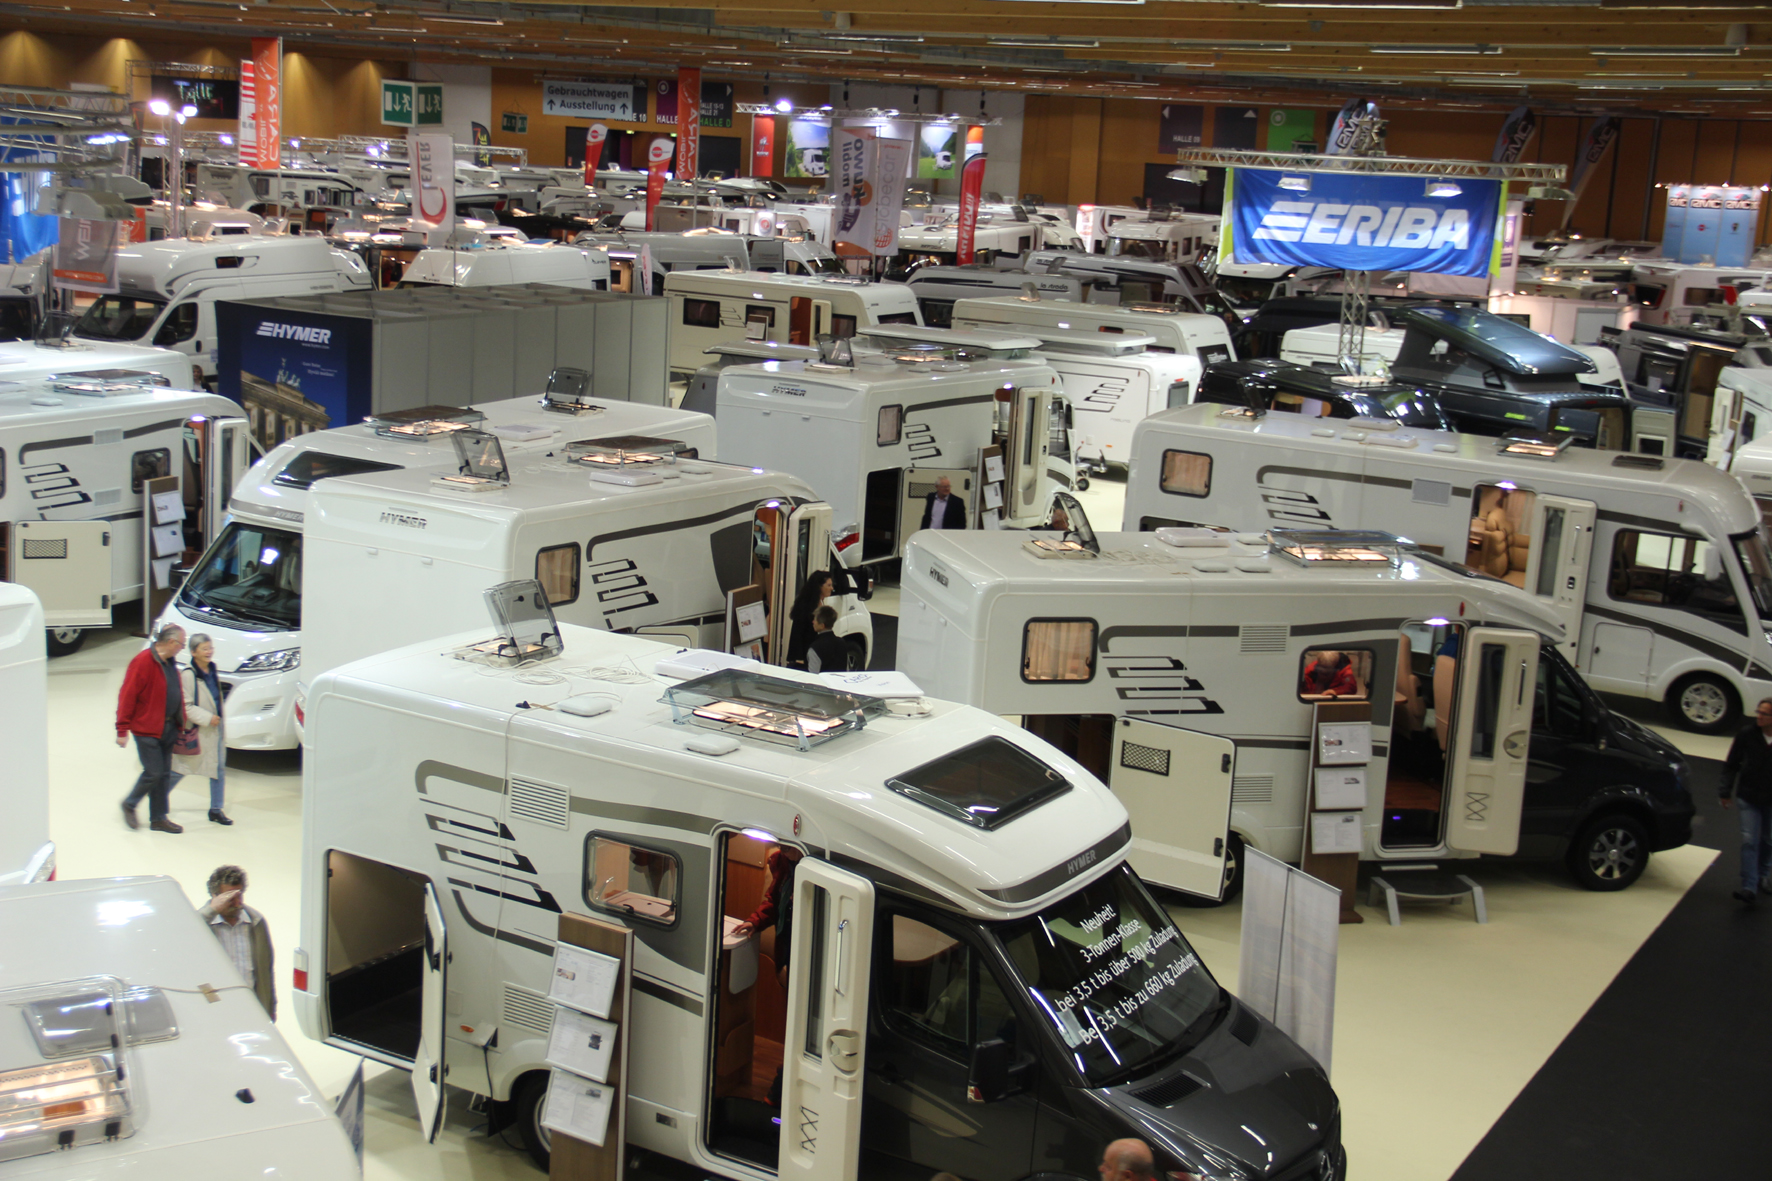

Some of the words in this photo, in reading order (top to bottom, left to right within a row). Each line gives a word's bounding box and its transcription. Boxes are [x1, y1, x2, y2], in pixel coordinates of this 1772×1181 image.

[548, 85, 628, 100] Gebrauchtwagen
[560, 100, 616, 113] Ausstellung
[639, 114, 646, 122] 10
[656, 114, 678, 124] HALLE
[700, 118, 723, 127] HALLE
[1302, 203, 1469, 250] ERIBA
[272, 323, 332, 344] HYMER
[379, 512, 427, 529] HYMER
[1067, 850, 1096, 874] HYMER
[1080, 904, 1116, 934] Neuheit!
[1080, 918, 1142, 963] 3-Tonnen-Klasse
[1149, 925, 1179, 949] Zuladung
[1127, 946, 1145, 964] 500
[1140, 941, 1156, 955] kg
[1108, 956, 1131, 976] über
[1167, 953, 1199, 978] Zuladung
[1090, 977, 1100, 990] t
[1094, 969, 1113, 986] bis
[1144, 976, 1164, 996] 660
[1157, 971, 1175, 986] kg
[1073, 981, 1092, 1000] 3,5
[1135, 990, 1149, 1004] zu
[1055, 991, 1077, 1012] bei
[1118, 996, 1138, 1014] bis
[1097, 1010, 1117, 1032] 3,5
[1114, 1006, 1125, 1019] t
